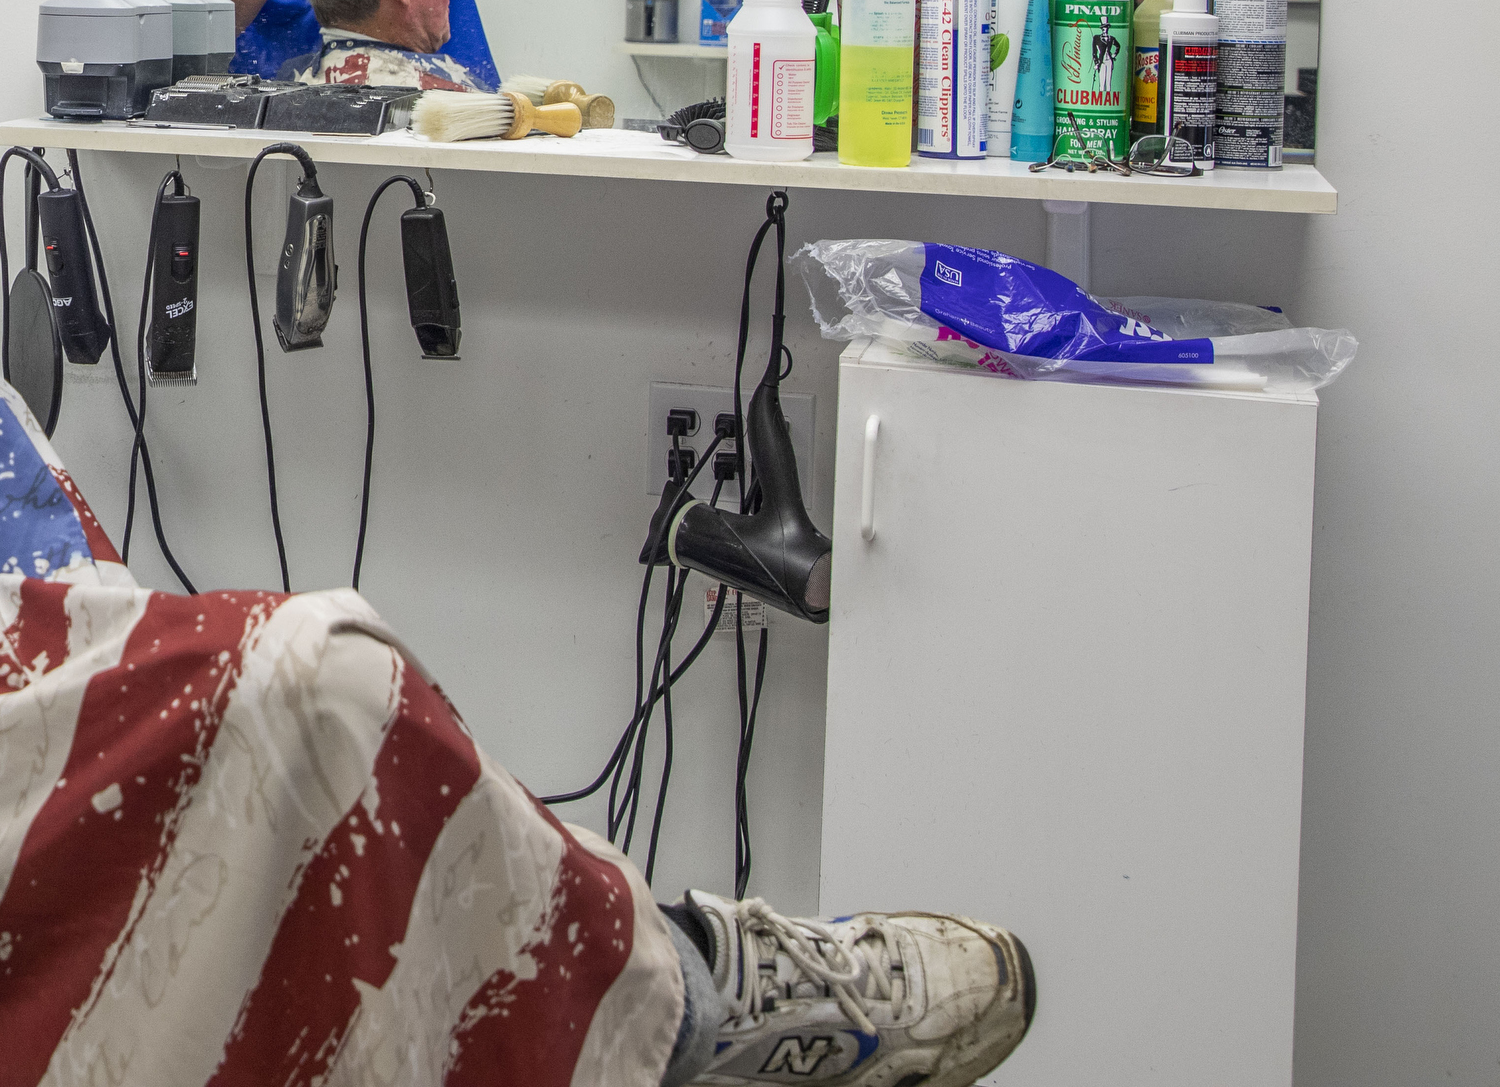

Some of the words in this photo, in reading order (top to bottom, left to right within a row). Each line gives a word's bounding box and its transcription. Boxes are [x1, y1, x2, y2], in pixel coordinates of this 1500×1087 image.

[1065, 4, 1120, 16] PINAUD
[941, 29, 952, 71] Clean
[1056, 88, 1121, 106] CLUBMAN
[938, 264, 959, 281] USA
[166, 300, 194, 319] EXCEL
[1110, 300, 1143, 322] SANEK
